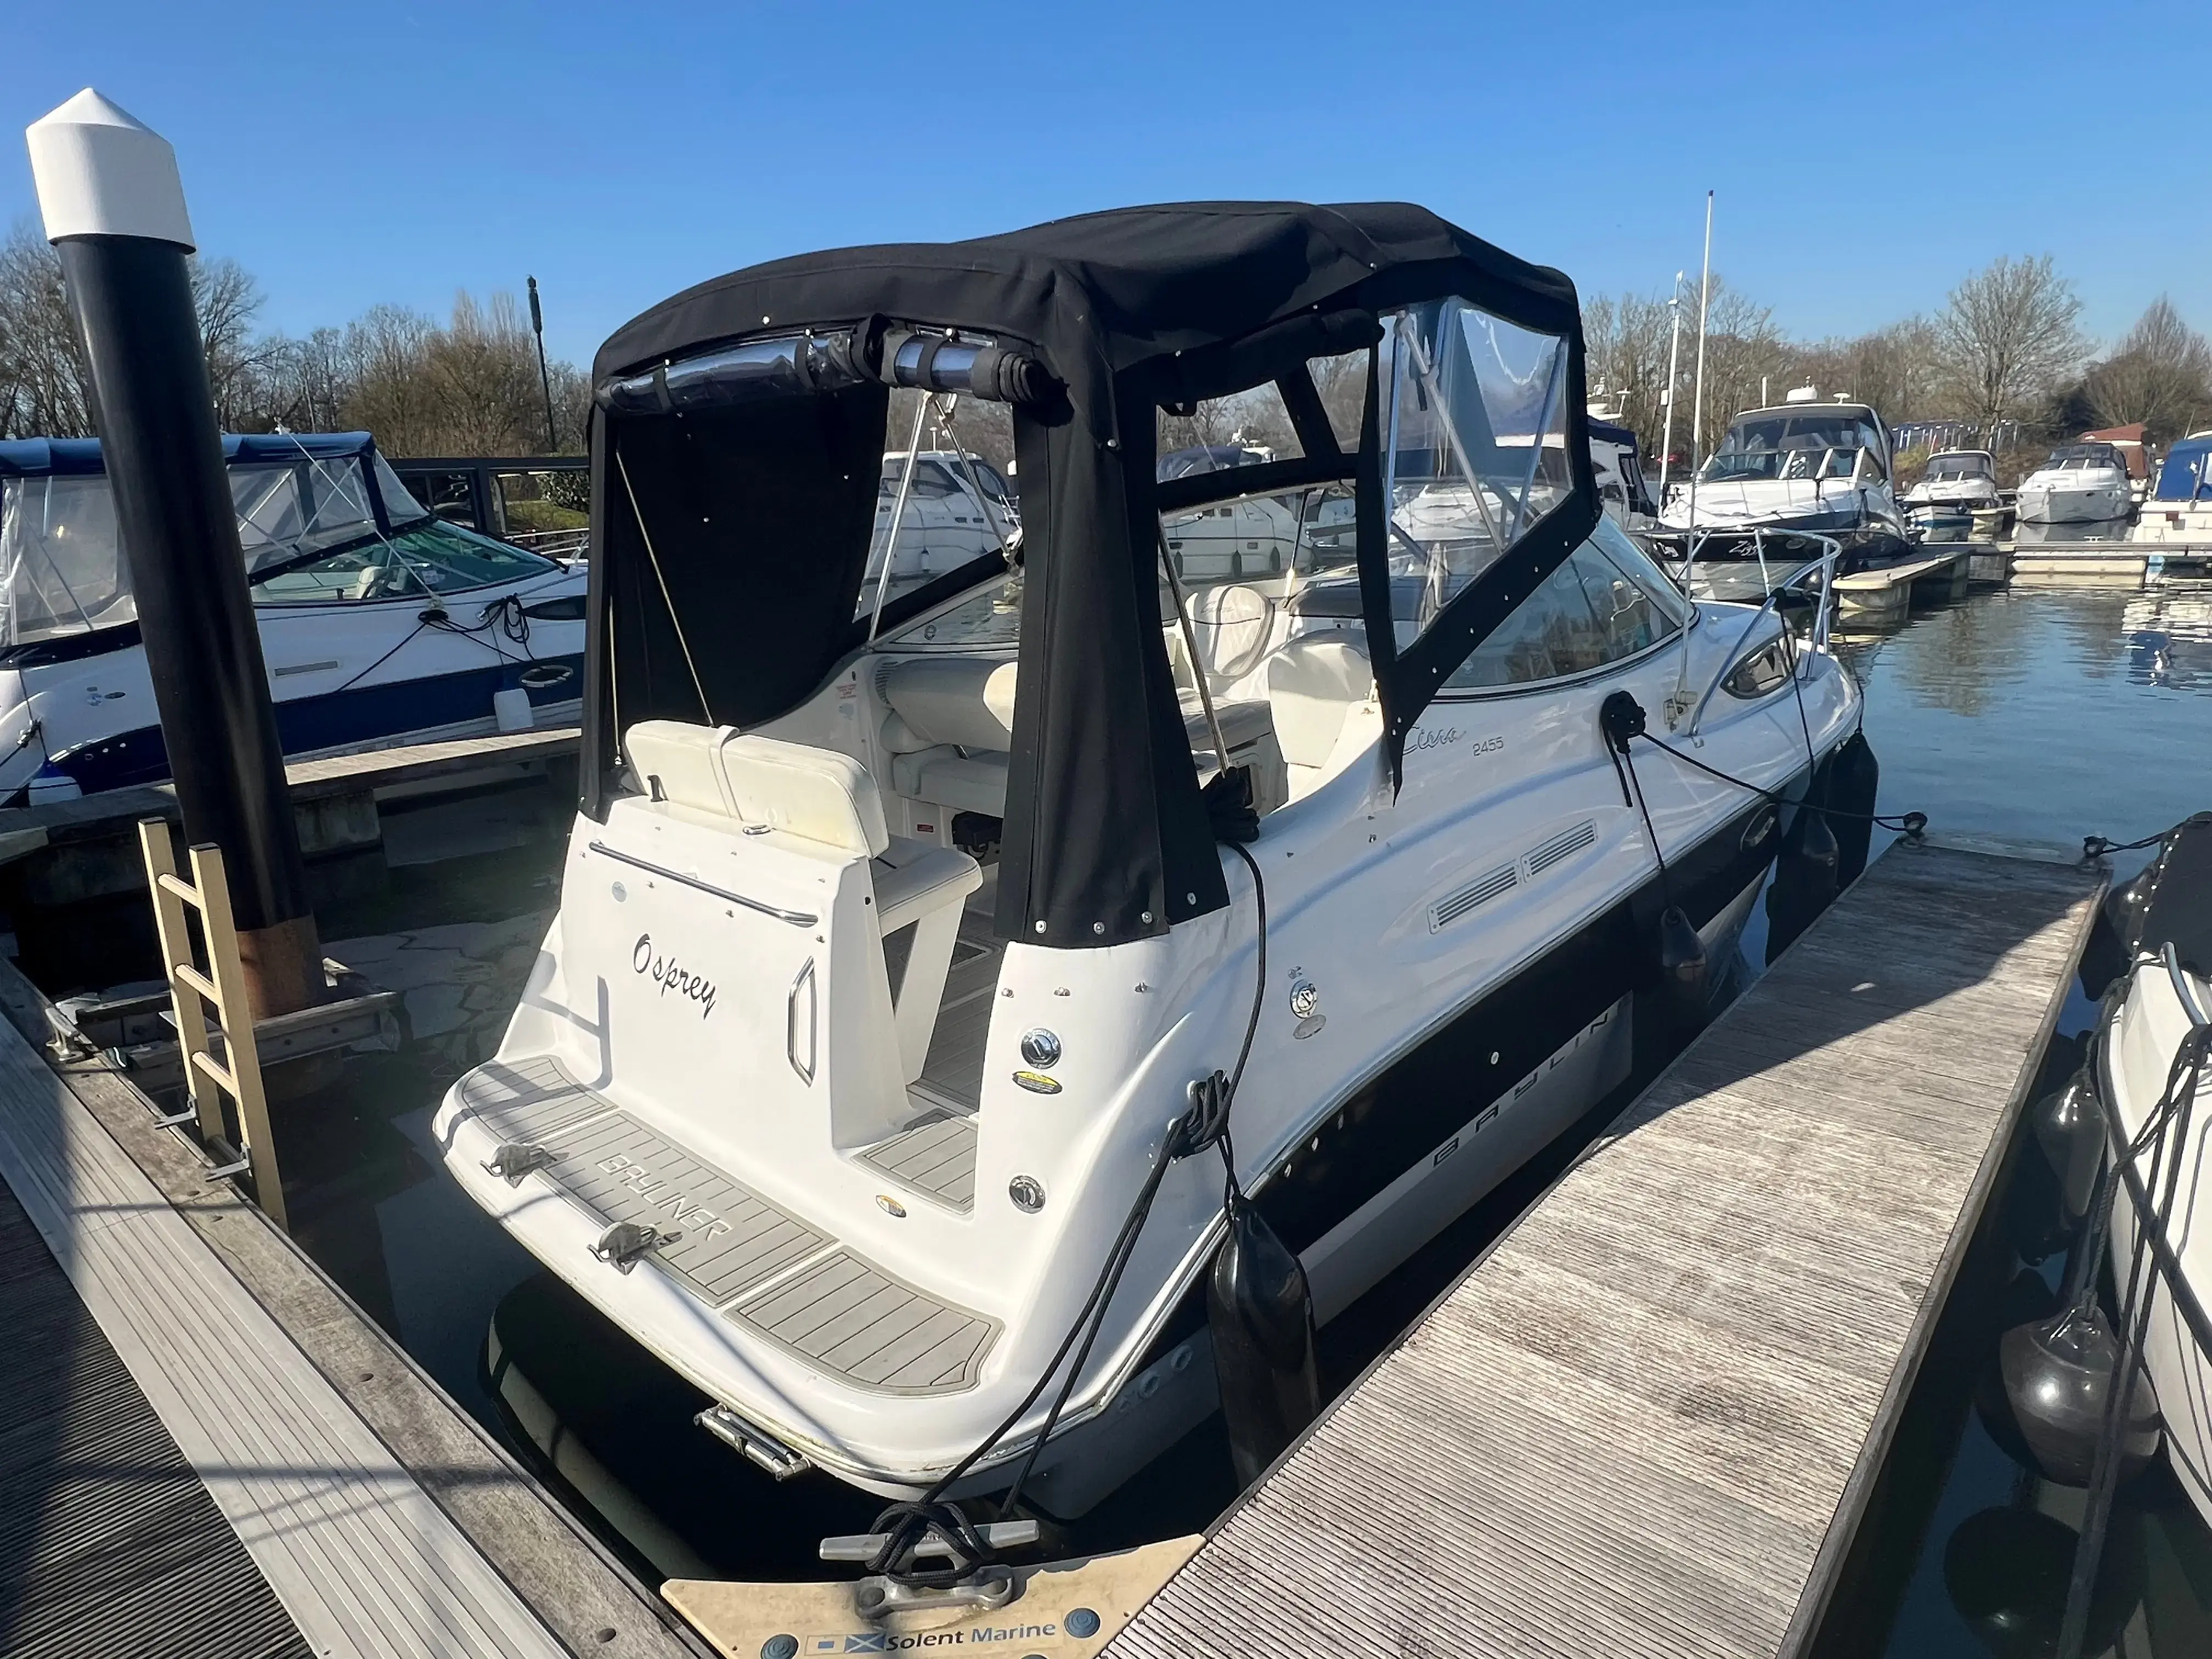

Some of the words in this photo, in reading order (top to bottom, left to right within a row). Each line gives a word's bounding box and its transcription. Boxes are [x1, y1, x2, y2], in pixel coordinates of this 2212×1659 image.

[1472, 736, 1504, 757] 2455
[633, 933, 716, 1020] Osprey
[1433, 1000, 1622, 1167] BAYLIN
[595, 1152, 735, 1241] BAYLINER
[885, 1630, 964, 1651] Solent
[971, 1623, 1056, 1643] Marine
